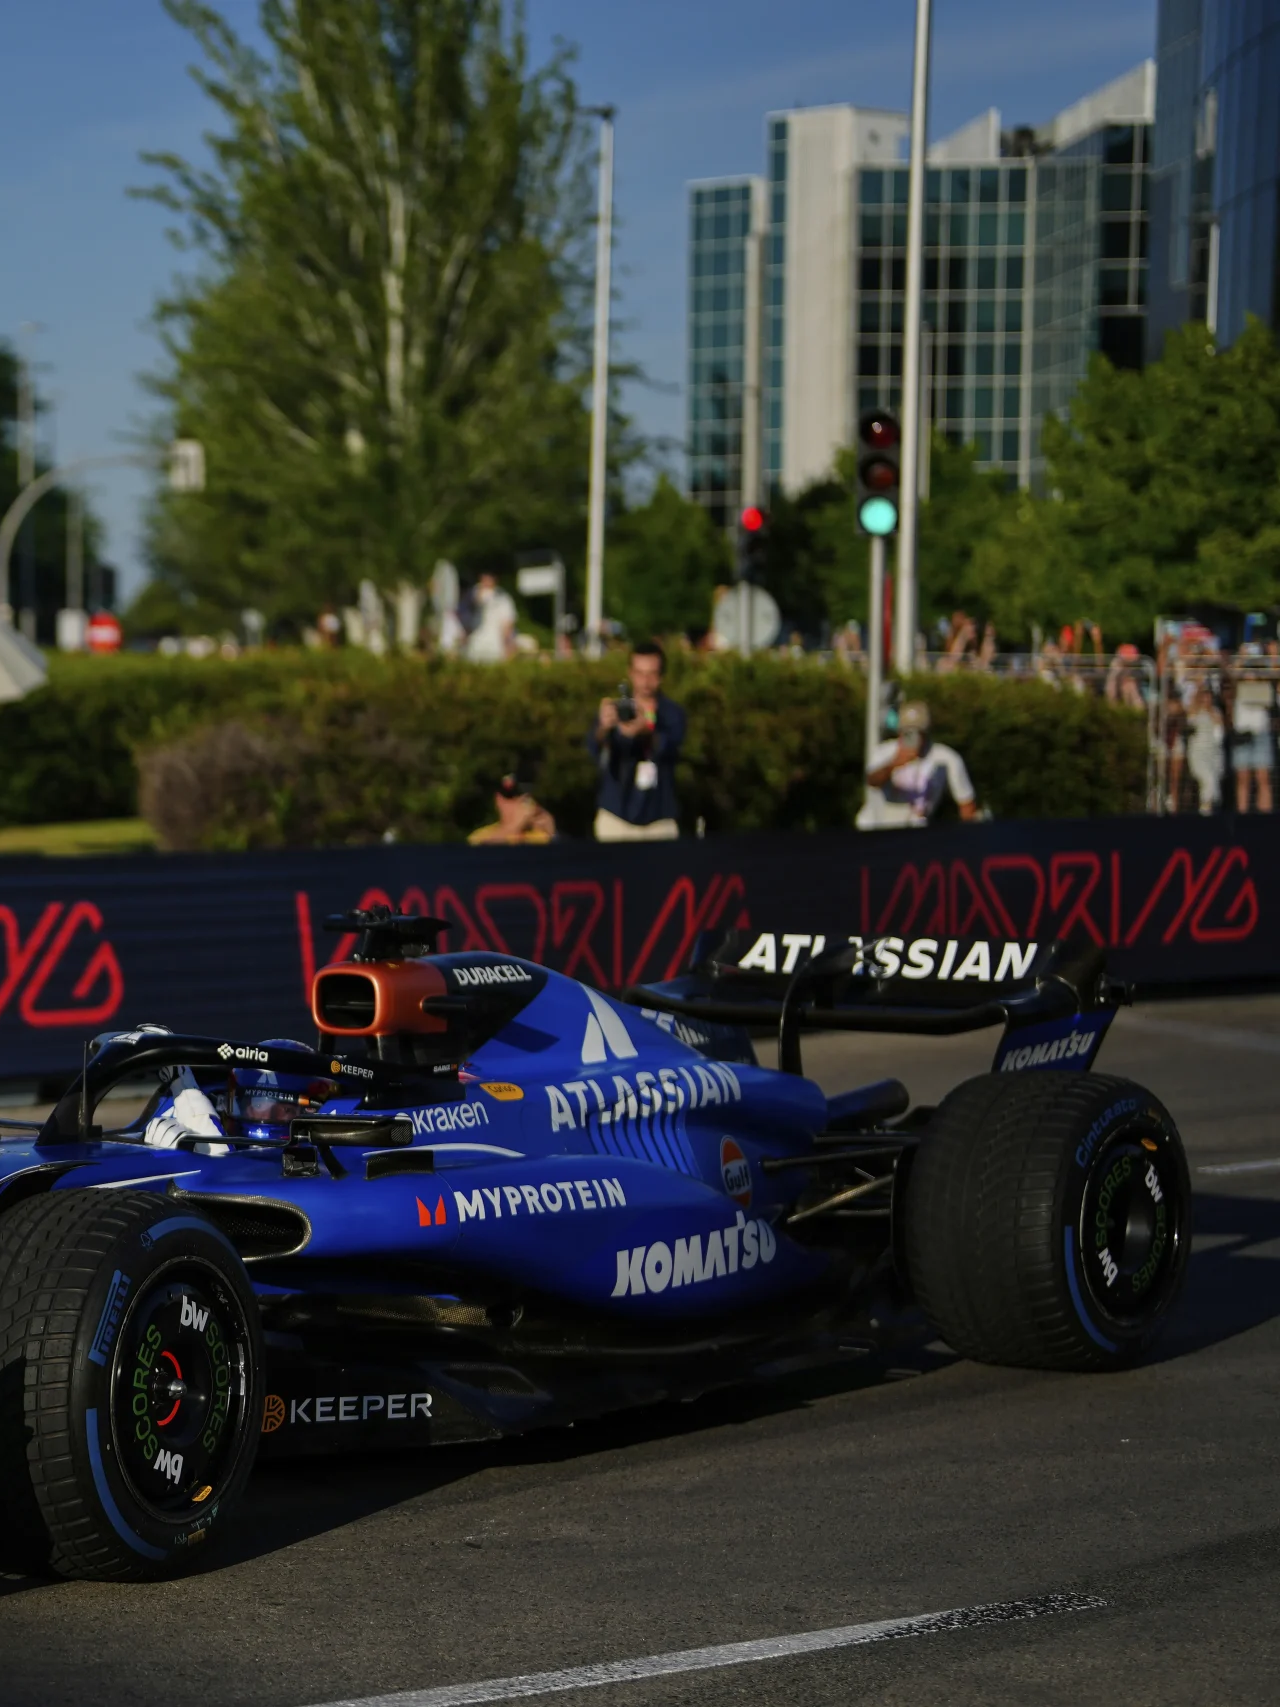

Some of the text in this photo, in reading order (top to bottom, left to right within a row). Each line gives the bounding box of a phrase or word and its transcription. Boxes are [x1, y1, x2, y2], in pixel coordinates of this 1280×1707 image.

[452, 964, 533, 987] DURACELL
[738, 933, 1038, 984] ATSSIAN
[235, 1047, 269, 1063] airia
[1001, 1028, 1096, 1072] KOMATSU
[341, 1064, 374, 1080] KEEPER
[245, 1089, 294, 1102] MYPROTEIN
[544, 1062, 742, 1132] ATLASSIAN
[412, 1101, 489, 1134] kraken
[724, 1165, 750, 1191] Gulf
[454, 1178, 627, 1223] MYPROTEIN
[610, 1209, 777, 1297] KOMATSU
[88, 1269, 132, 1367] PIRELLI
[180, 1294, 209, 1332] bw
[132, 1324, 163, 1460] SCORES
[202, 1321, 229, 1454] SCORES
[290, 1393, 433, 1424] KEEPER
